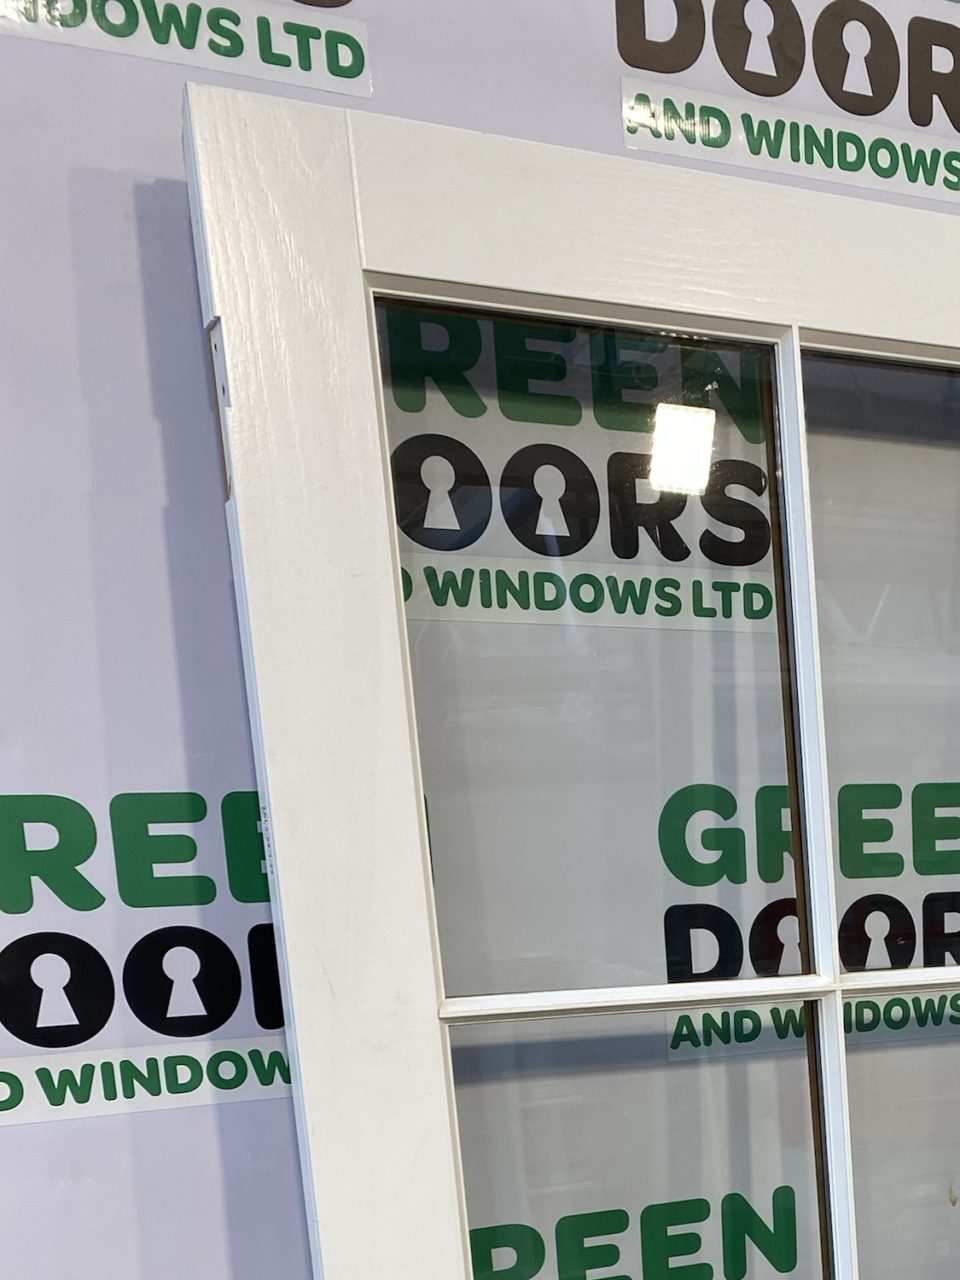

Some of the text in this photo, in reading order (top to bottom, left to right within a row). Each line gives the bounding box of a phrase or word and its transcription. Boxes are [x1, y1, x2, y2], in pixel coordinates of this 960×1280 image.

[256, 16, 365, 79] LTD
[626, 93, 731, 148] AND
[423, 565, 683, 617] WINDOWS
[692, 579, 773, 620] LTD
[670, 1009, 762, 1050] AND
